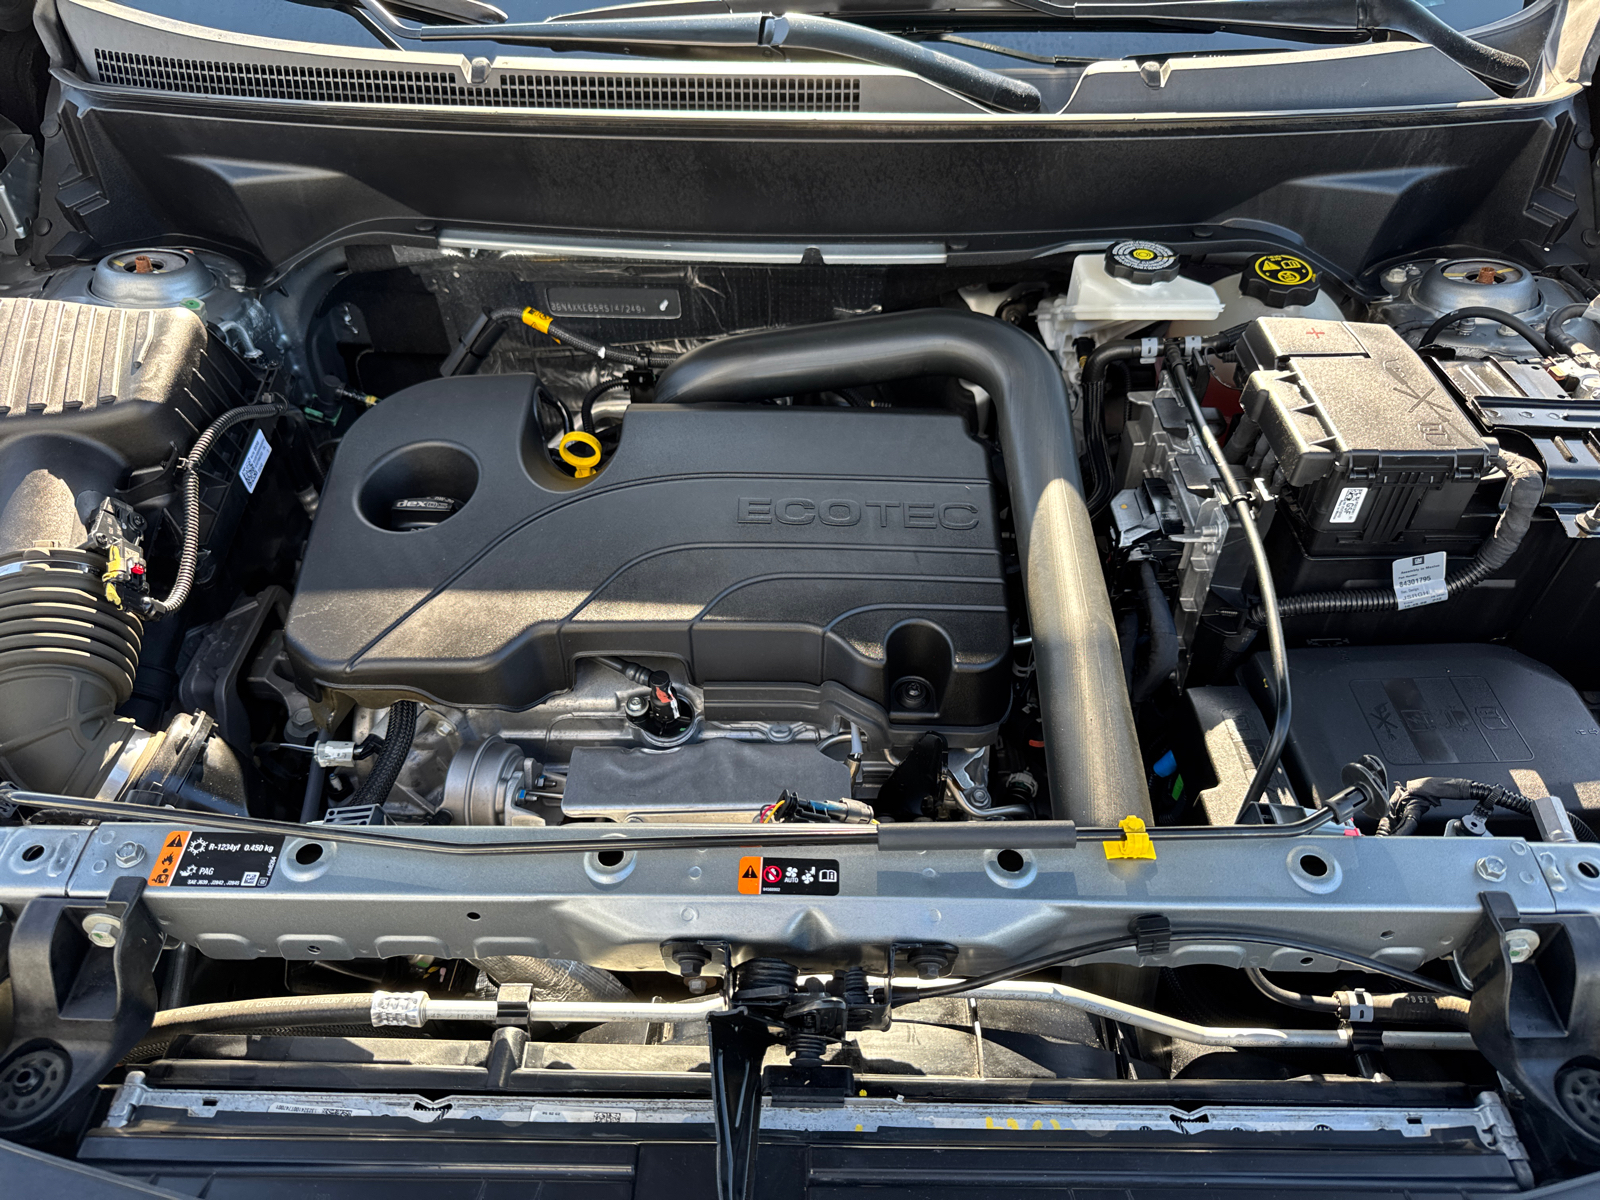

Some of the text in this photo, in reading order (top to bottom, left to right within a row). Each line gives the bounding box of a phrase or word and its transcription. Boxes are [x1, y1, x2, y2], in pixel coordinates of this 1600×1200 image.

[396, 499, 449, 509] dexos
[737, 497, 979, 531] ECOTEC
[1399, 575, 1432, 588] 84301795
[208, 843, 274, 853] R-1234yf 0.450 kg
[198, 867, 215, 876] PAG
